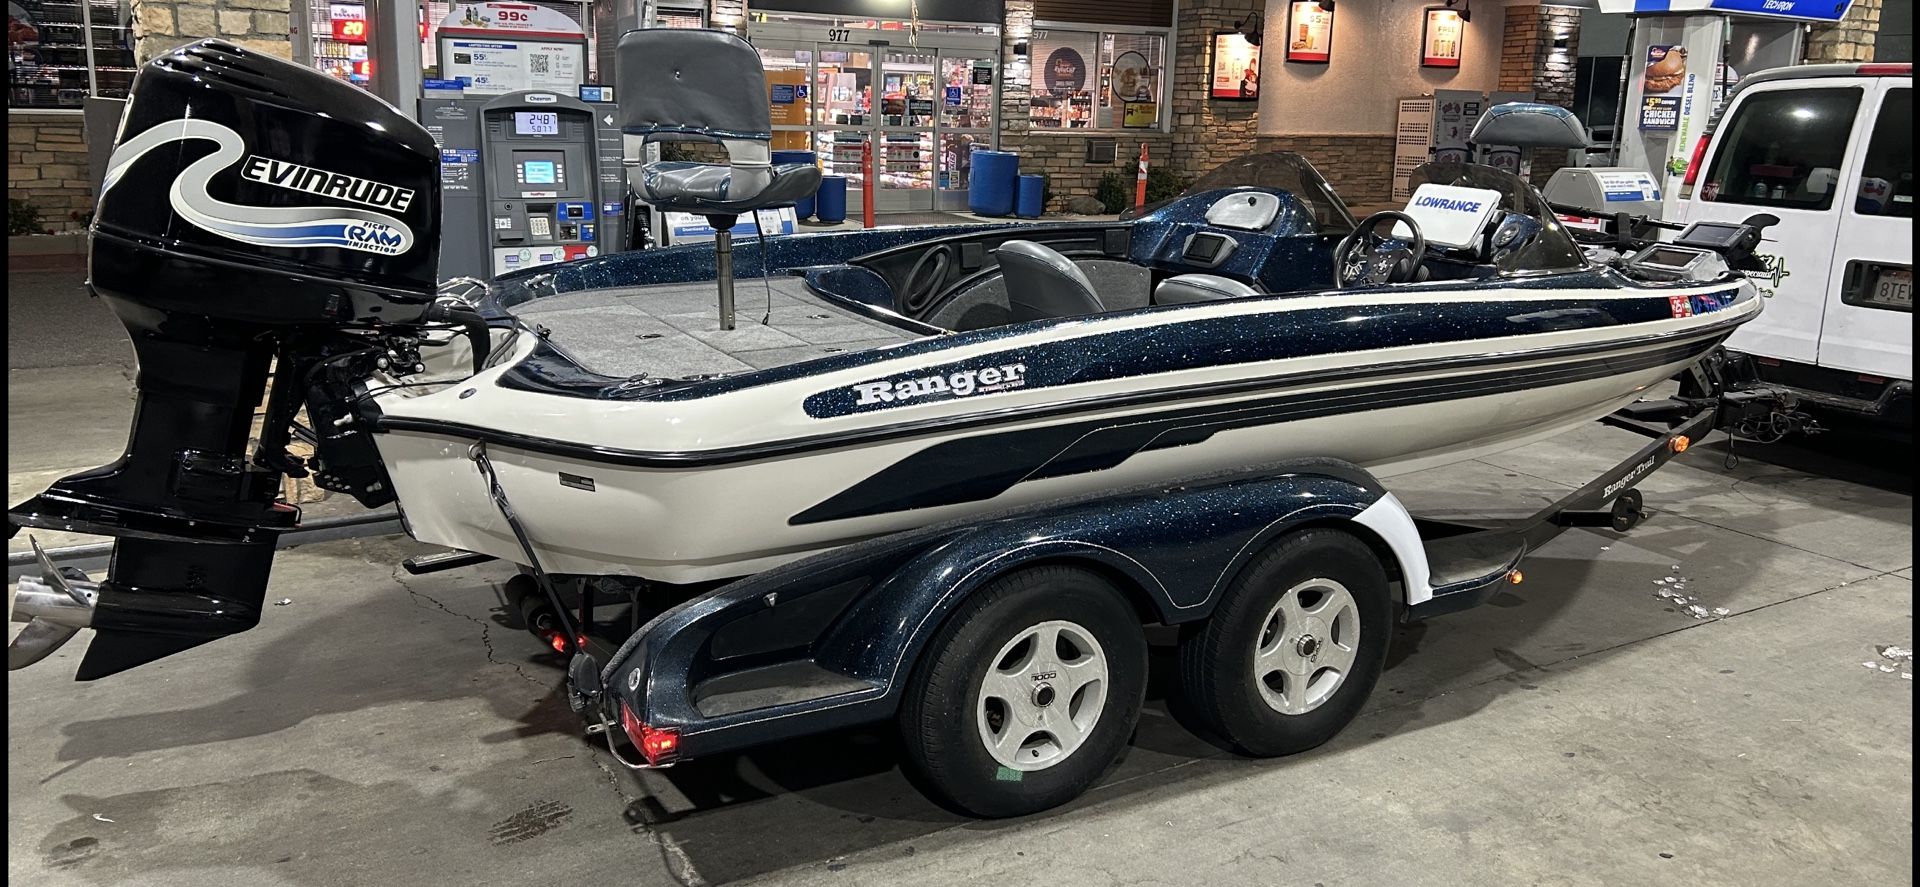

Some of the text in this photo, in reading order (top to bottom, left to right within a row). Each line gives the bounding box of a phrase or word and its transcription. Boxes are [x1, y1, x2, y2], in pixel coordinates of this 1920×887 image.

[1762, 0, 1796, 11] TECHRON
[828, 29, 850, 42] 977
[1033, 30, 1048, 40] 977
[1687, 73, 1695, 94] BLEND
[1644, 110, 1676, 118] CHICKEN
[1683, 95, 1693, 115] DIESEL
[243, 155, 414, 212] EVINRUDE
[1415, 195, 1482, 213] LOWRANCE
[348, 225, 402, 248] RAM
[348, 240, 397, 254] INJECTION
[853, 362, 1027, 406] Ranger
[1602, 455, 1656, 499] Ranger Trail
